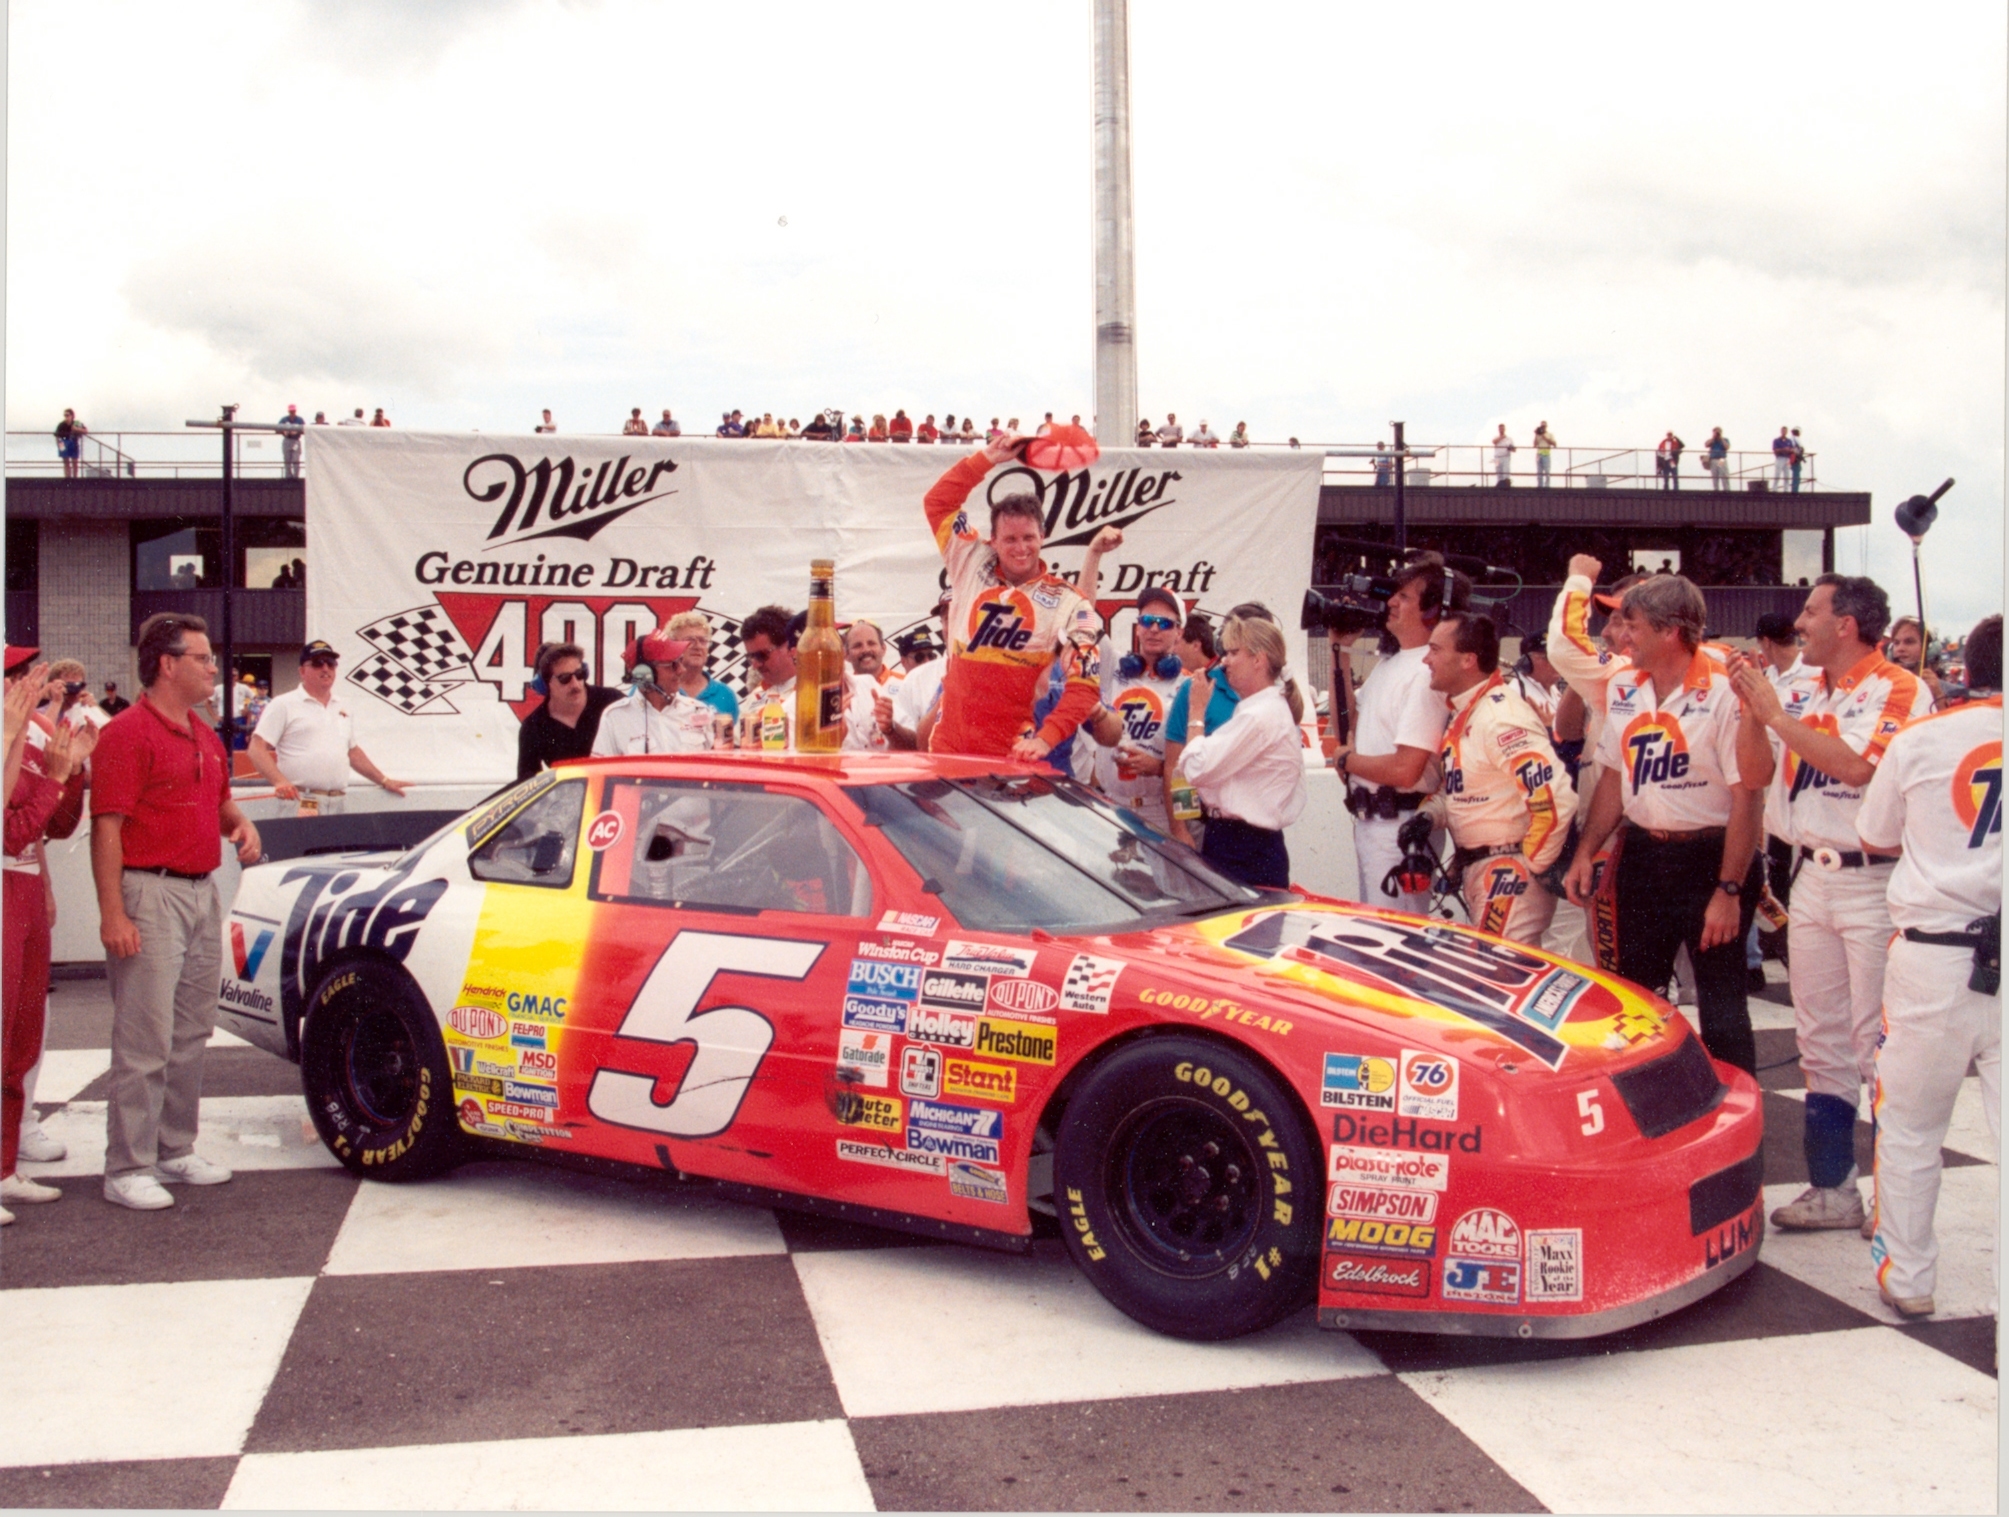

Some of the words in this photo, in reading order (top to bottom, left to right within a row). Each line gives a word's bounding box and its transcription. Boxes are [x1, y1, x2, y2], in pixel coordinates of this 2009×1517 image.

[463, 453, 678, 542] Miller
[987, 467, 1182, 540] Miller
[414, 551, 594, 587] Genuine
[601, 557, 716, 590] Draft
[1111, 562, 1217, 593] Draft
[966, 602, 1033, 653] Tide
[1119, 703, 1163, 740] Tide
[1628, 732, 1690, 796] Tide
[1516, 760, 1553, 797] Tide
[471, 777, 549, 837] PYROIL
[591, 820, 617, 843] AC
[1487, 868, 1528, 900] Tide
[279, 851, 449, 1060] Tide
[858, 941, 910, 961] Winston
[910, 948, 939, 965] Cup
[850, 960, 922, 989] BUSCH
[949, 961, 972, 970] HARD
[974, 963, 1015, 975] CHARGER
[219, 977, 273, 1013] Valvoline
[320, 972, 356, 1006] EAGLE
[462, 983, 507, 998] Hendrick
[924, 977, 984, 1002] Gillette
[1015, 982, 1054, 1010] PONT
[1064, 990, 1107, 1003] Western
[507, 992, 567, 1018] GMAC
[846, 1000, 906, 1021] Goody's
[1071, 1000, 1096, 1012] Auto
[1139, 988, 1294, 1036] GOODYEAR
[470, 1009, 503, 1036] PONT
[587, 929, 829, 1139] 5
[910, 1010, 974, 1046] Holley
[909, 1032, 956, 1044] CARBS
[977, 1022, 1054, 1061] Prestone
[522, 1050, 556, 1069] MSD
[843, 1046, 885, 1064] Gatorade
[477, 1061, 515, 1078] Wellcraft
[948, 1063, 1013, 1092] Stant
[1413, 1062, 1446, 1086] 76
[505, 1082, 557, 1104] Bowman
[853, 1098, 892, 1113] uto
[1323, 1091, 1393, 1108] BILSTEIN
[1402, 1095, 1434, 1104] OFFICIAL
[1436, 1098, 1455, 1106] FUEL
[361, 1067, 431, 1165] GOODYEAR
[910, 1100, 973, 1126] MICHIGAN
[971, 1110, 998, 1136] 77
[1576, 1089, 1605, 1136] 5
[907, 1128, 997, 1162] Bowman
[1174, 1061, 1293, 1226] GOODYEAR
[1333, 1114, 1481, 1153] DieHard
[840, 1143, 894, 1160] PERFECT
[896, 1151, 941, 1168] CIRCLE
[952, 1183, 976, 1197] BELTS
[1360, 1173, 1387, 1183] SPRAY
[1337, 1189, 1428, 1217] SIMPSON
[1067, 1185, 1106, 1261] EAGLE
[1328, 1218, 1435, 1249] MOOG
[1454, 1211, 1518, 1245] MAC
[1454, 1241, 1517, 1257] TOOLS
[1540, 1246, 1574, 1260] Maxx
[1332, 1261, 1420, 1287] Edelbrock
[1446, 1262, 1517, 1293] JE
[1540, 1261, 1575, 1275] Rookie
[1541, 1276, 1574, 1293] Year
